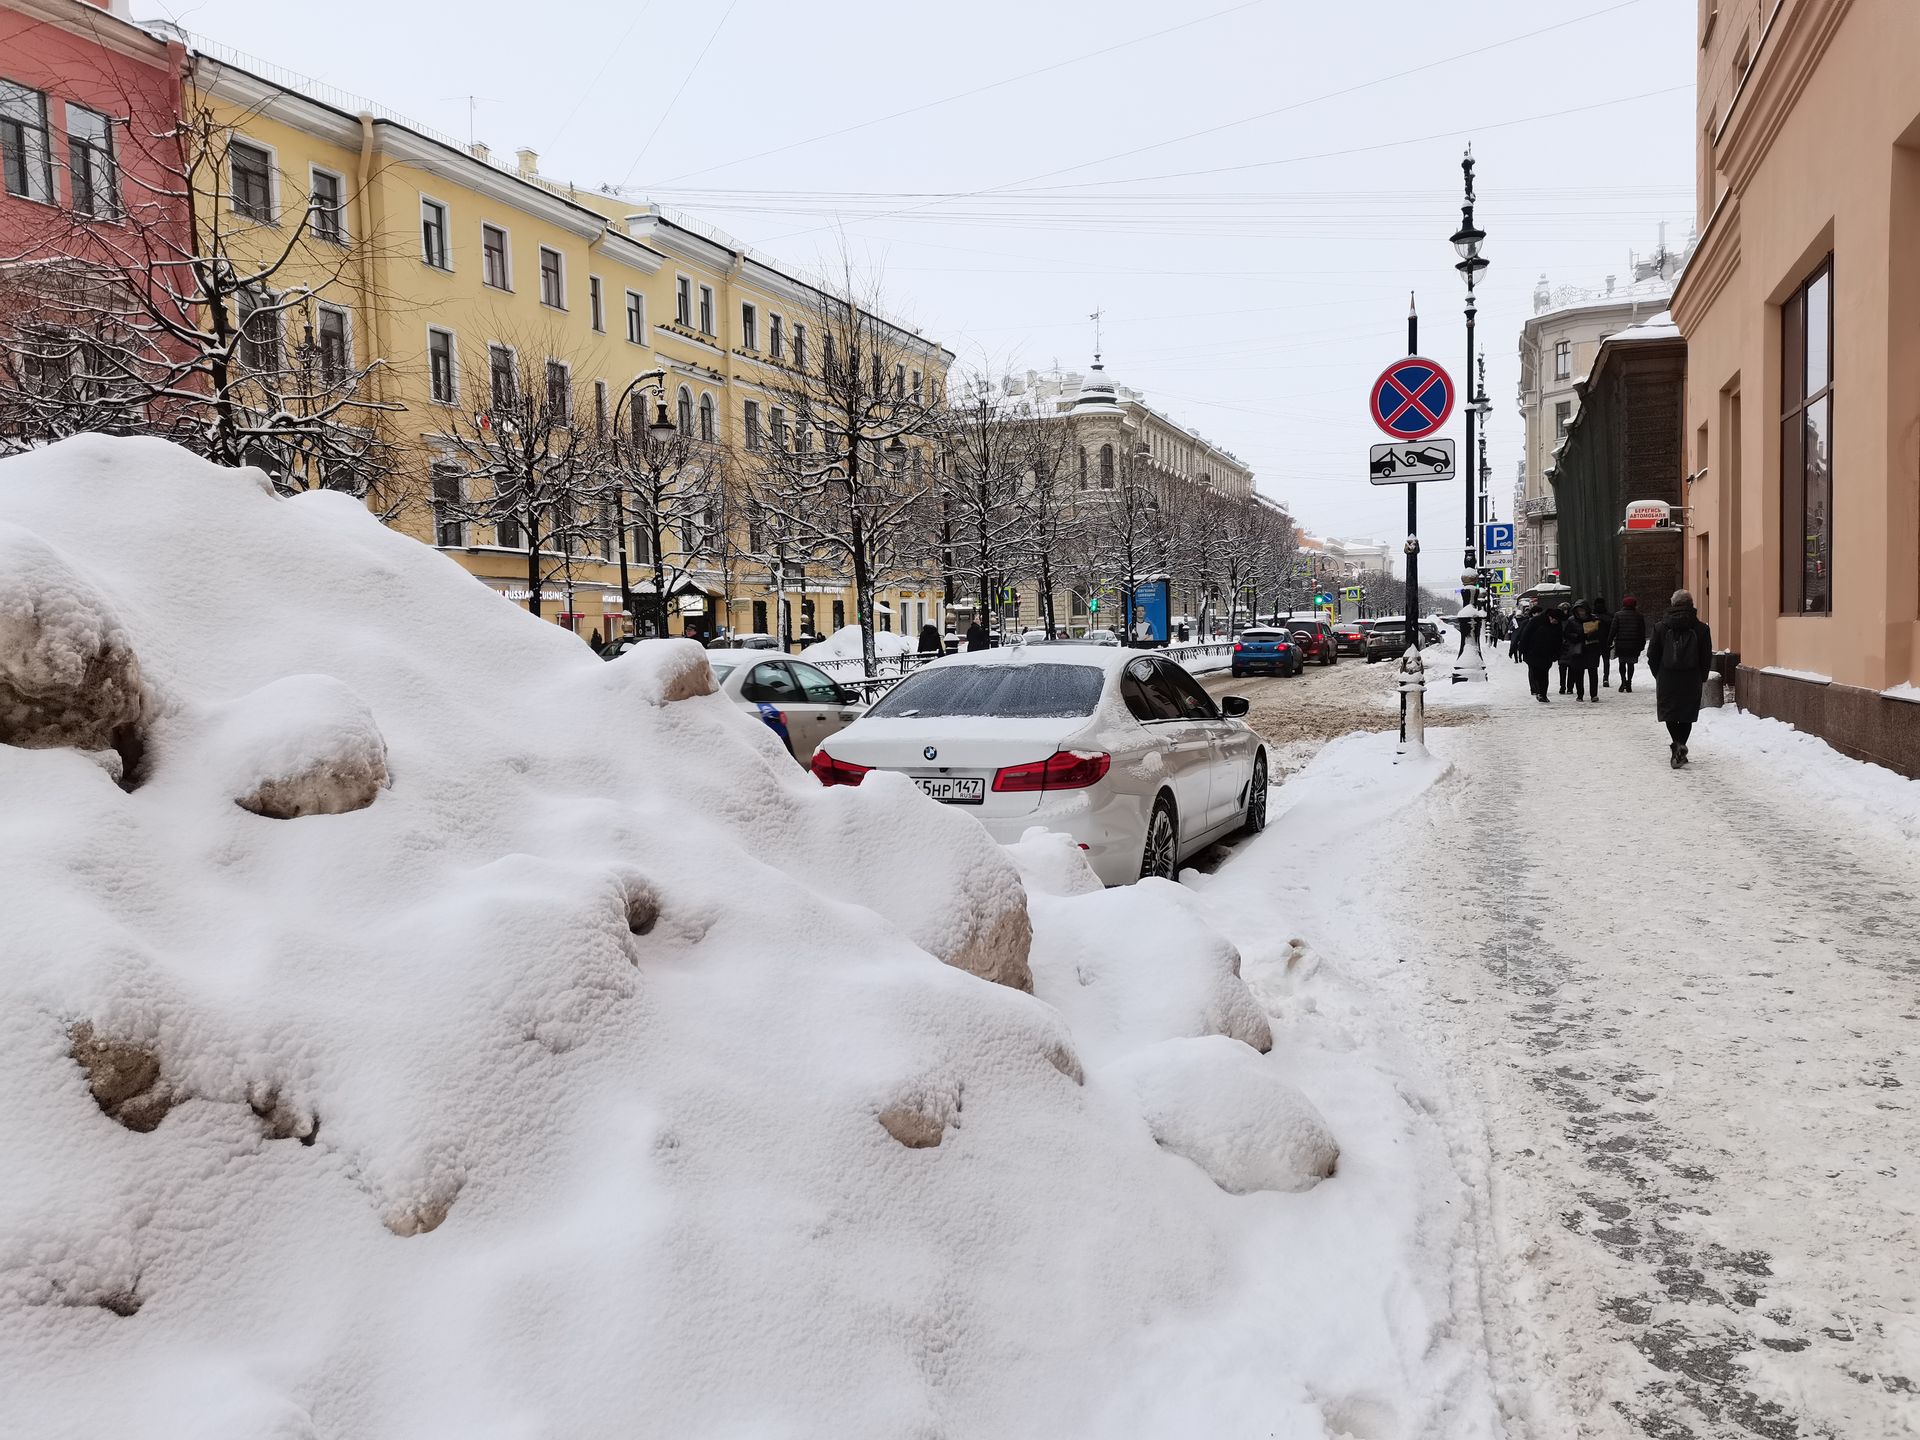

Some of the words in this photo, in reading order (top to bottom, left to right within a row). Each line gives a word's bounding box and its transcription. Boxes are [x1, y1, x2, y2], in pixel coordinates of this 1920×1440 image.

[1493, 526, 1508, 548] P
[504, 590, 532, 600] RUSSIA
[915, 780, 951, 797] 5HP
[955, 780, 979, 793] 147
